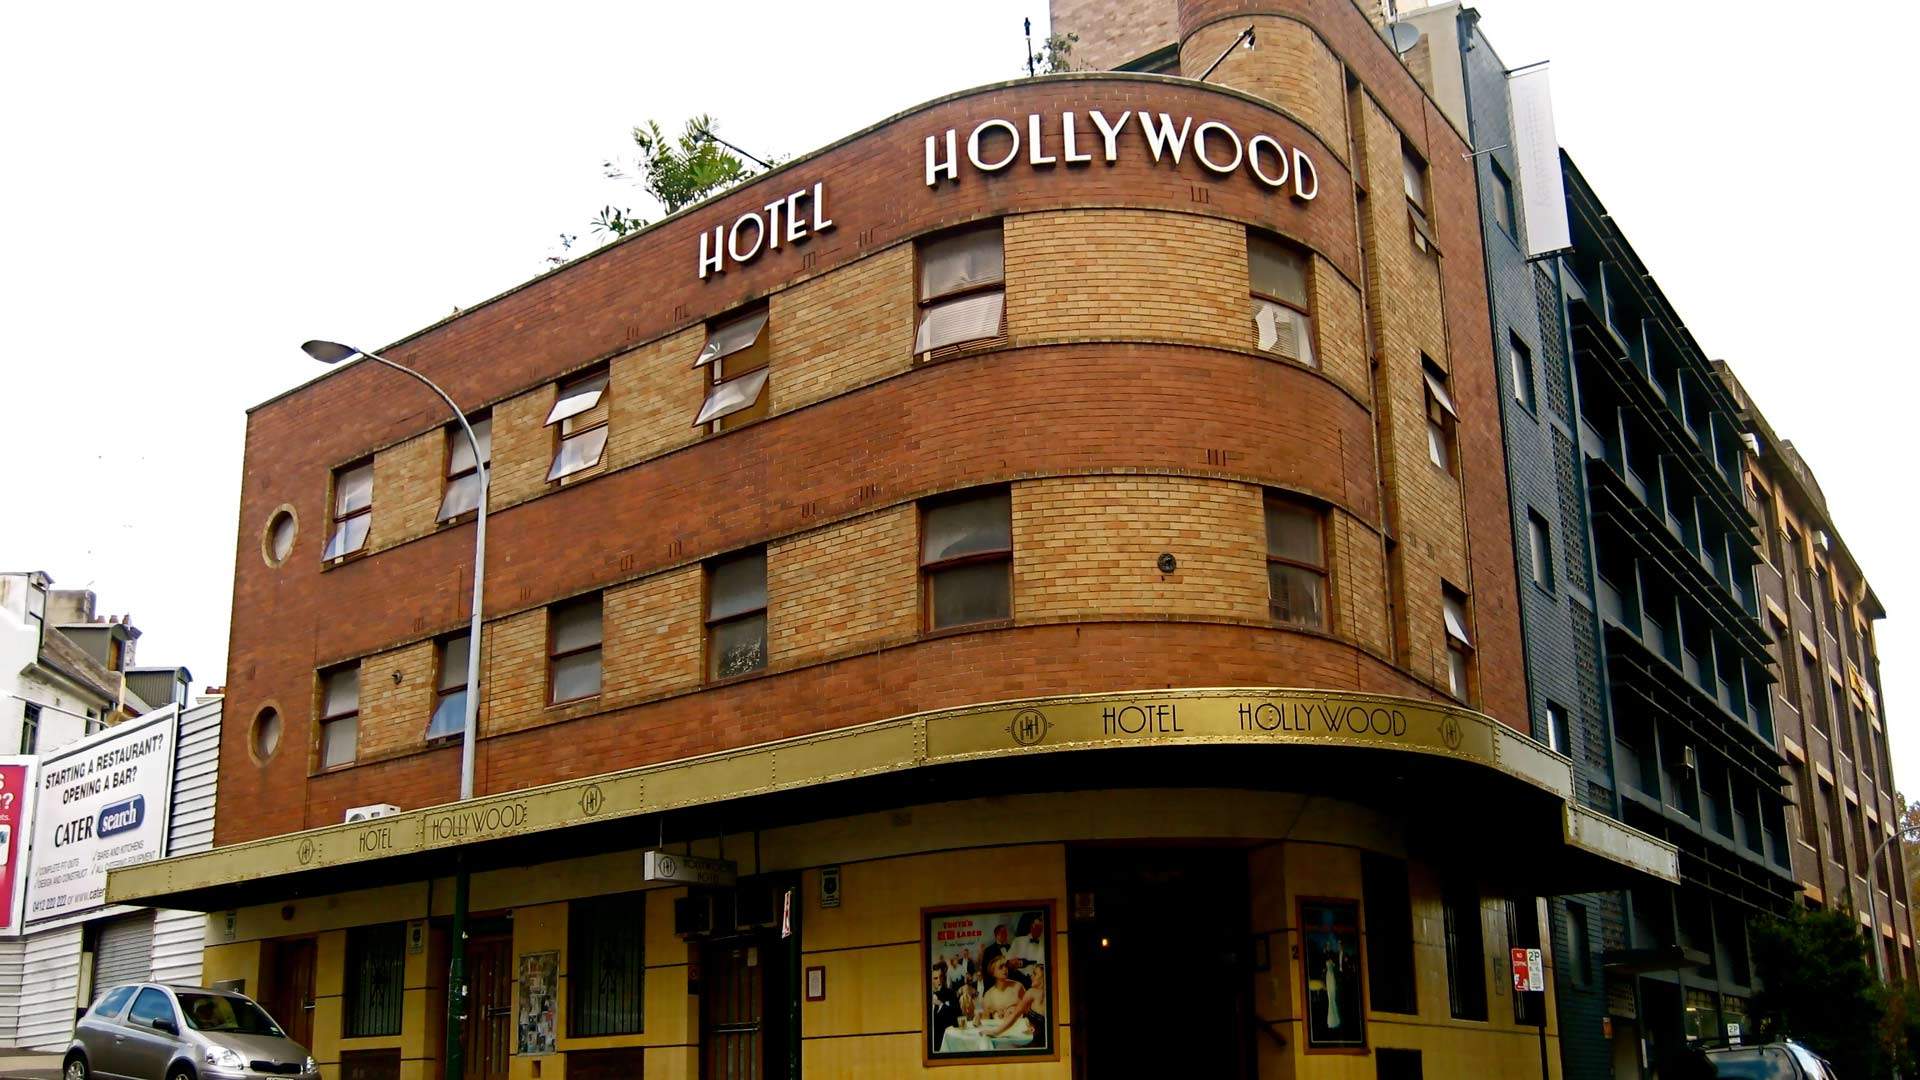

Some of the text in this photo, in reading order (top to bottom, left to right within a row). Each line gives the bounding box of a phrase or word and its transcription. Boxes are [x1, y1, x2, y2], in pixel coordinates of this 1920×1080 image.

[699, 110, 1320, 279] HOTEL HOLLYWOOD
[1102, 704, 1184, 735] HOTEL
[1238, 702, 1407, 737] HOLLYWOOD
[46, 733, 163, 789] STARTING A RESTAURANT?
[63, 766, 137, 805] OPENING A BAR?
[55, 800, 137, 848] CATER search
[359, 828, 393, 853] HOTEL
[432, 803, 525, 840] HOLLYWOOD
[1528, 951, 1540, 962] 2P
